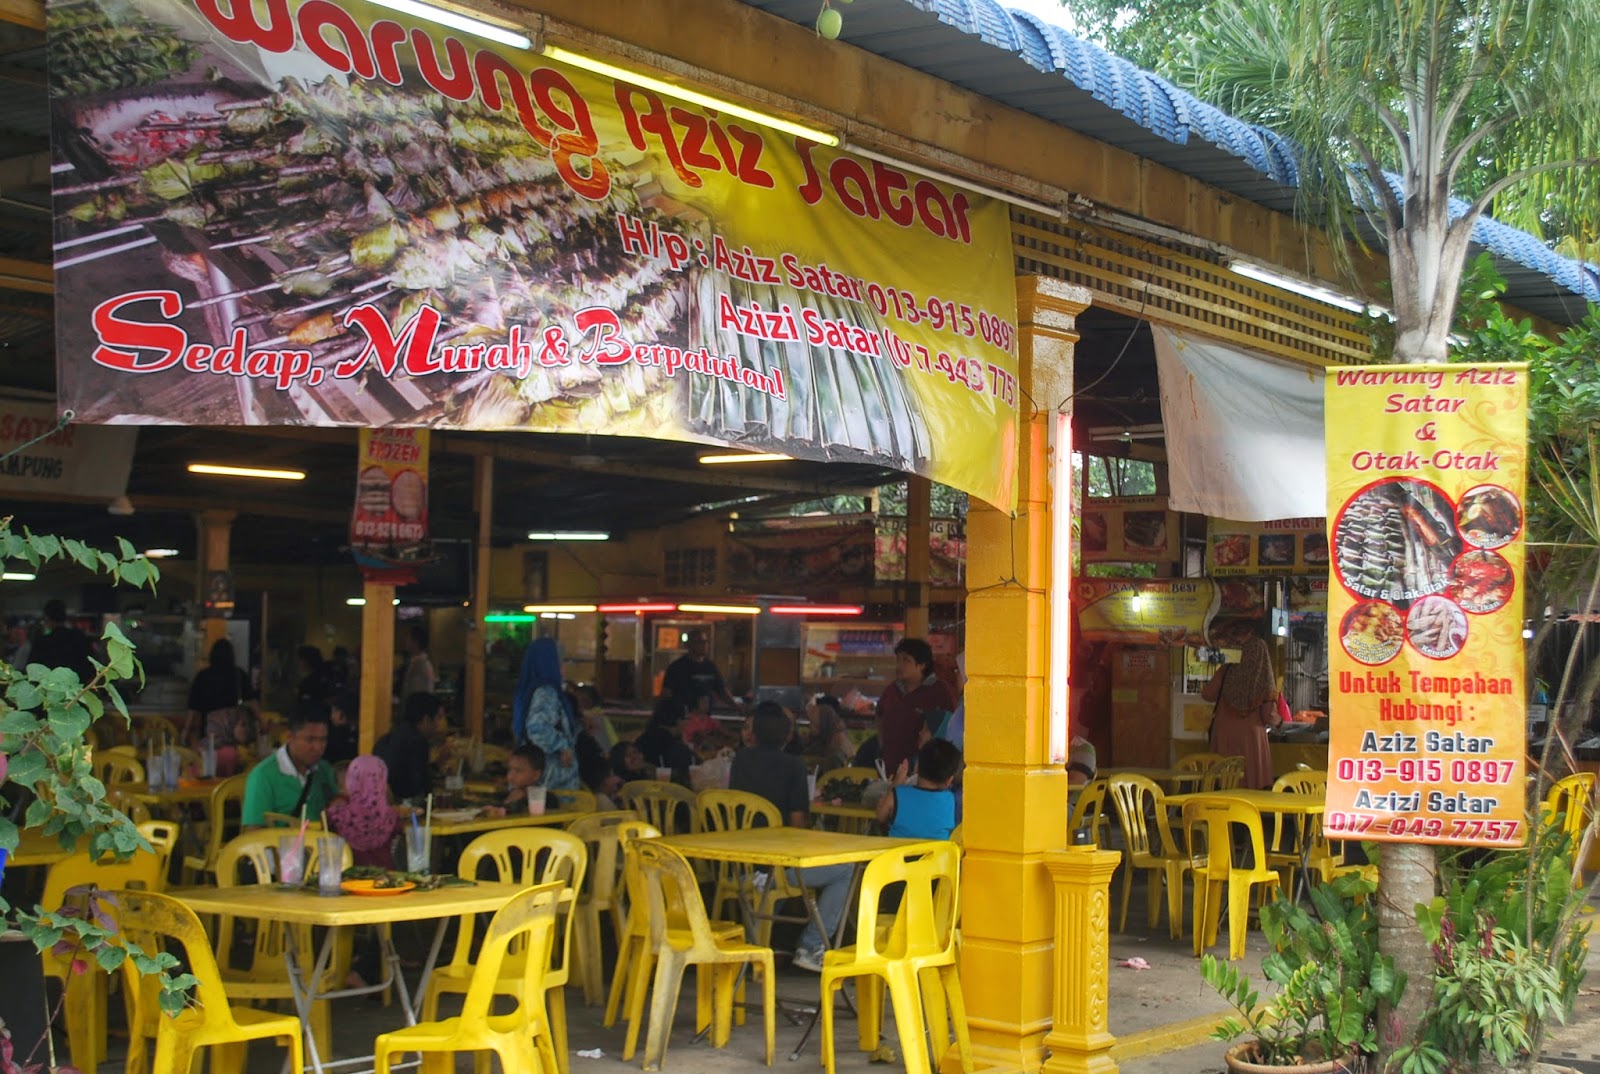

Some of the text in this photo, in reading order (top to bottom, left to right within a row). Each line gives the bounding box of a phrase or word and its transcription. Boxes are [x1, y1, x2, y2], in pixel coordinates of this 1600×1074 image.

[614, 79, 775, 189] Aziz
[794, 136, 972, 244] Satar
[616, 213, 691, 272] H/p
[713, 234, 782, 286] Aziz
[787, 252, 863, 303] Satar
[91, 289, 787, 402] Sedap, Murah & Berpatutan!
[719, 293, 800, 343] Azizi
[801, 308, 882, 359] Satar
[987, 363, 1018, 411] 775
[1336, 367, 1516, 389] Warung Aziz
[1384, 393, 1465, 414] Satar
[1415, 421, 1437, 441] &
[368, 439, 421, 463] FROZEN
[1351, 450, 1499, 470] Otak-Otak
[1343, 577, 1378, 598] Satar
[1339, 671, 1512, 699] Untuk Tempahan
[1379, 698, 1463, 726] Hubungi
[1360, 730, 1495, 754] Aziz Satar
[1337, 759, 1516, 784] 013-915 0897
[1353, 789, 1498, 814] Azizi Satar
[1450, 819, 1521, 842] 7757
